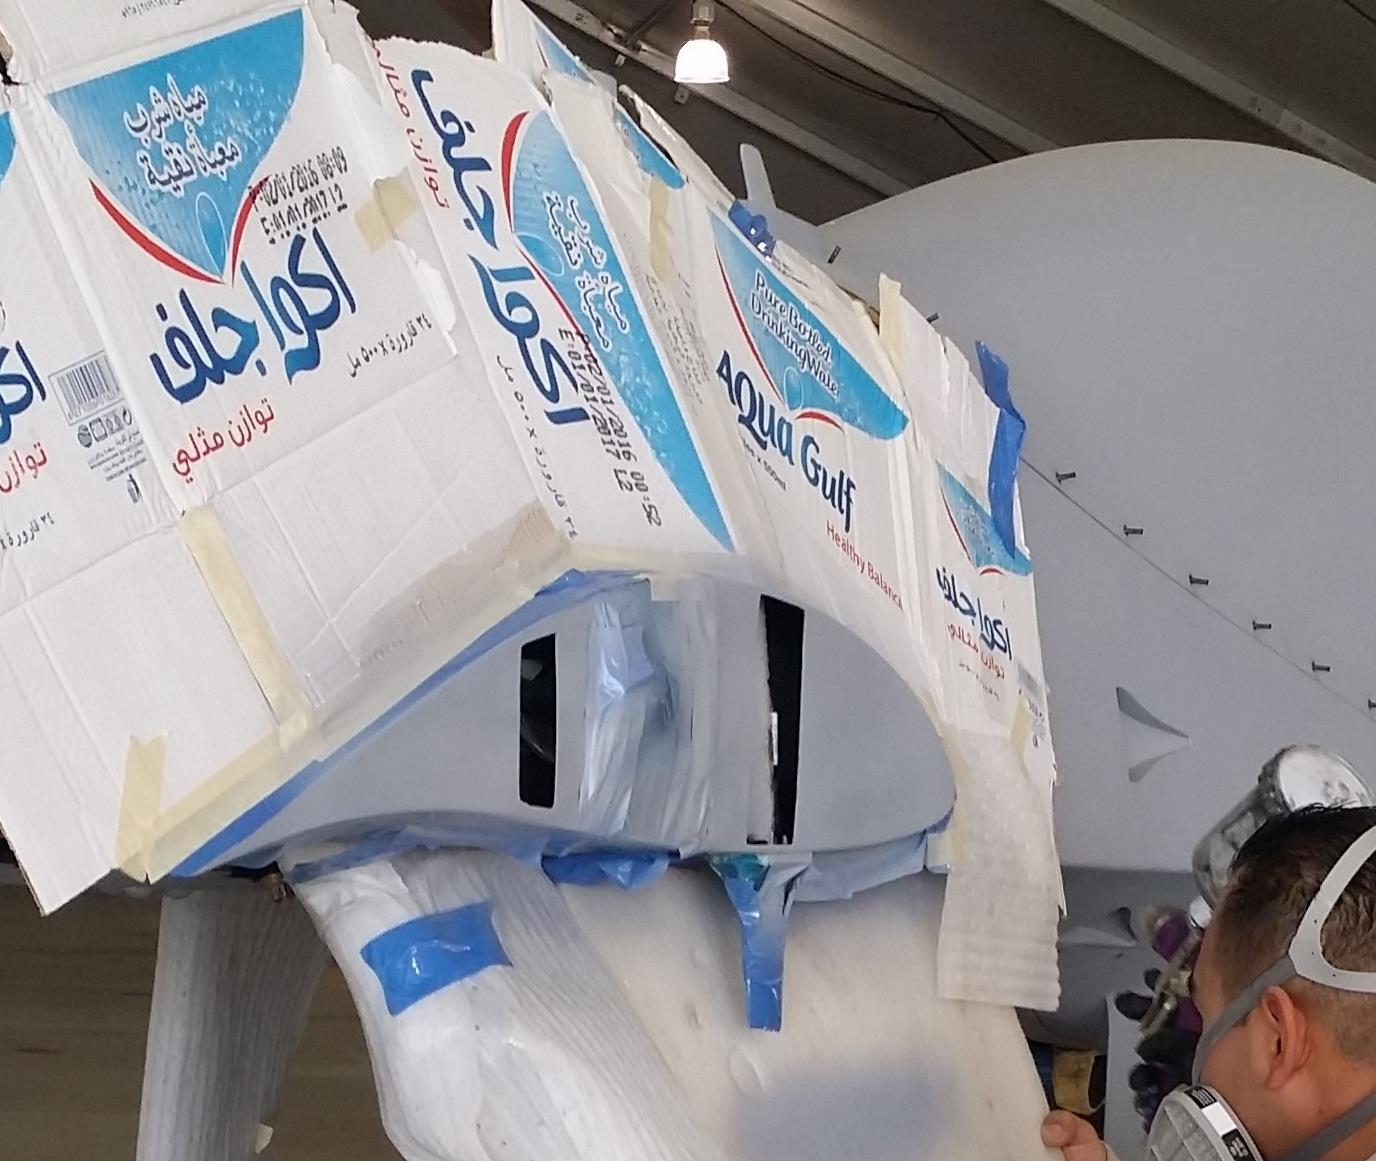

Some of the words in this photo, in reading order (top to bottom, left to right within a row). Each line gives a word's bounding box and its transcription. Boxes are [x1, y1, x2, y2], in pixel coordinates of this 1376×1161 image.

[124, 86, 173, 146] شرب
[168, 74, 207, 123] مياه
[138, 142, 197, 196] نقية
[406, 127, 450, 209] توازن
[411, 68, 499, 251] جلف
[600, 273, 627, 331] مياه
[756, 271, 786, 314] Pure
[150, 287, 267, 404] جلف
[751, 291, 806, 370] Drinking
[228, 398, 274, 447] توازن
[801, 435, 856, 533] Gulf
[826, 519, 865, 574] Healthy
[936, 566, 976, 626] جلف
